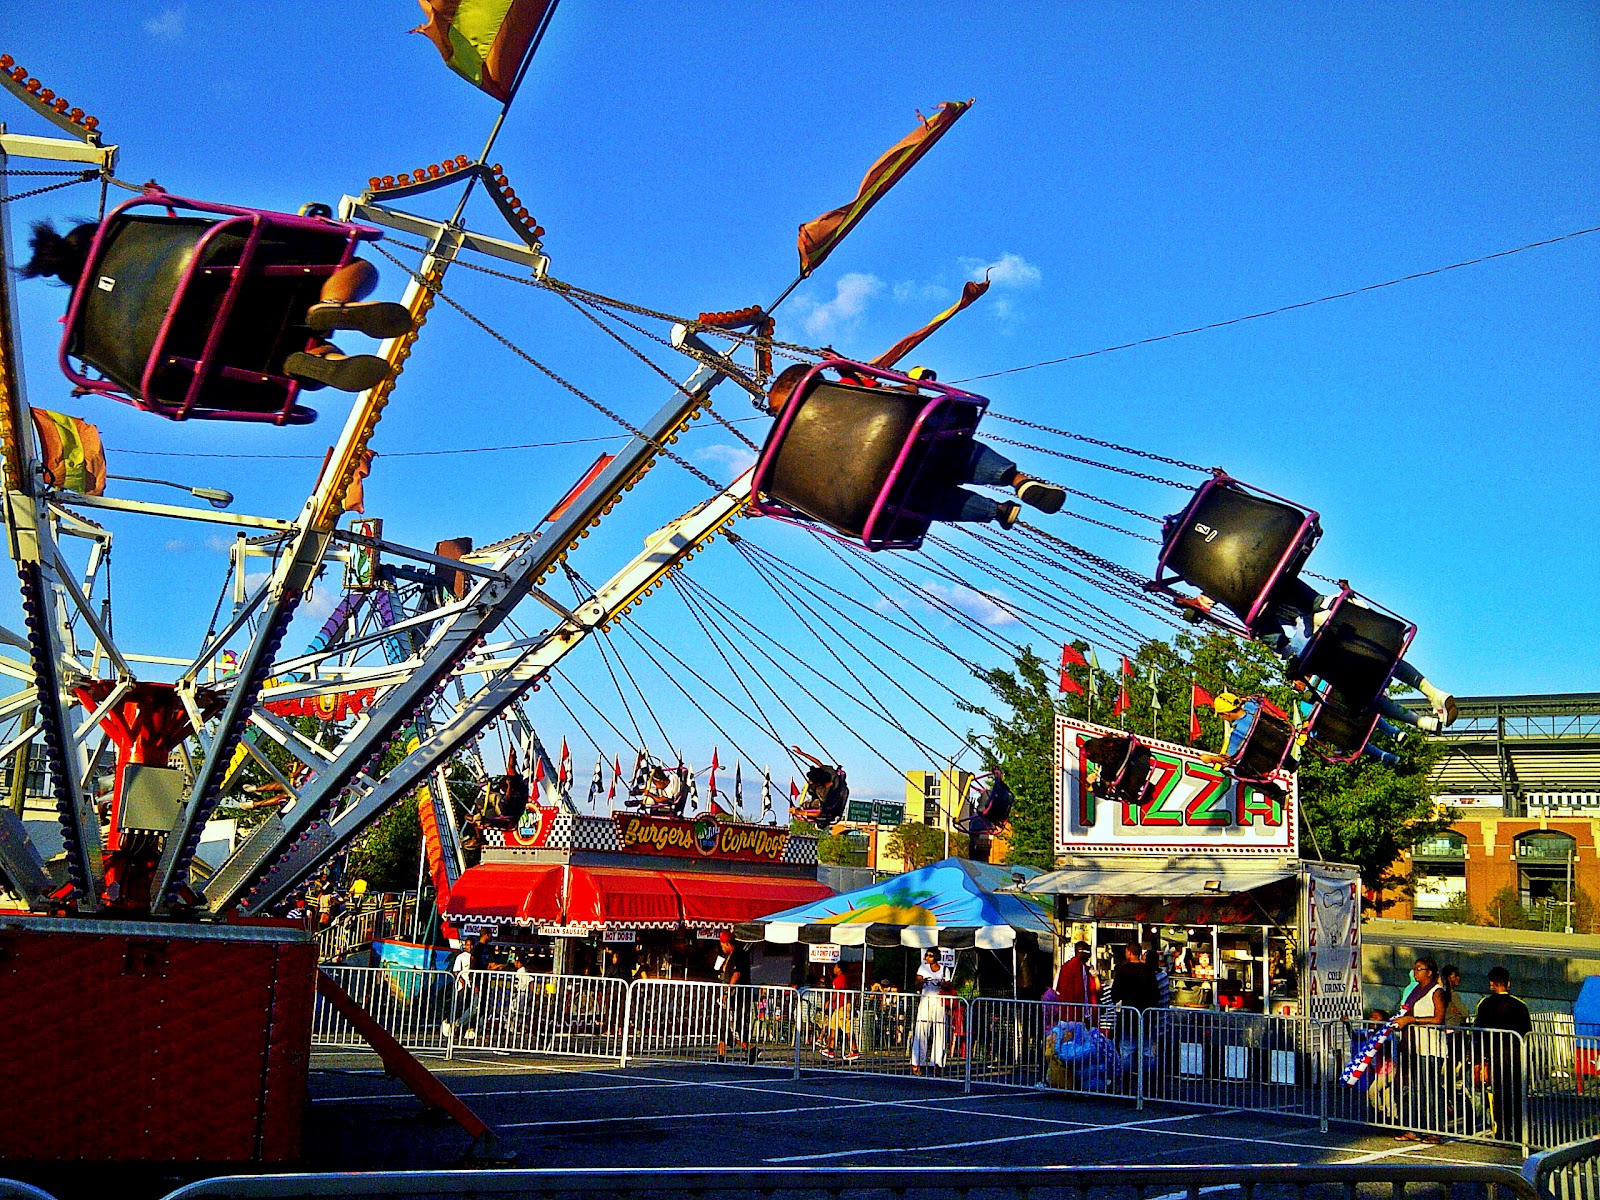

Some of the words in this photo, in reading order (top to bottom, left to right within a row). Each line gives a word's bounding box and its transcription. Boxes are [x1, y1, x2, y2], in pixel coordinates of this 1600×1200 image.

[1076, 733, 1282, 826] ZZA
[625, 818, 693, 850] Burgers
[562, 928, 588, 936] SAUSAGE
[605, 931, 616, 941] HOT
[617, 932, 633, 941] DOGS
[1327, 971, 1342, 981] COLD
[1324, 983, 1346, 993] DRINKS
